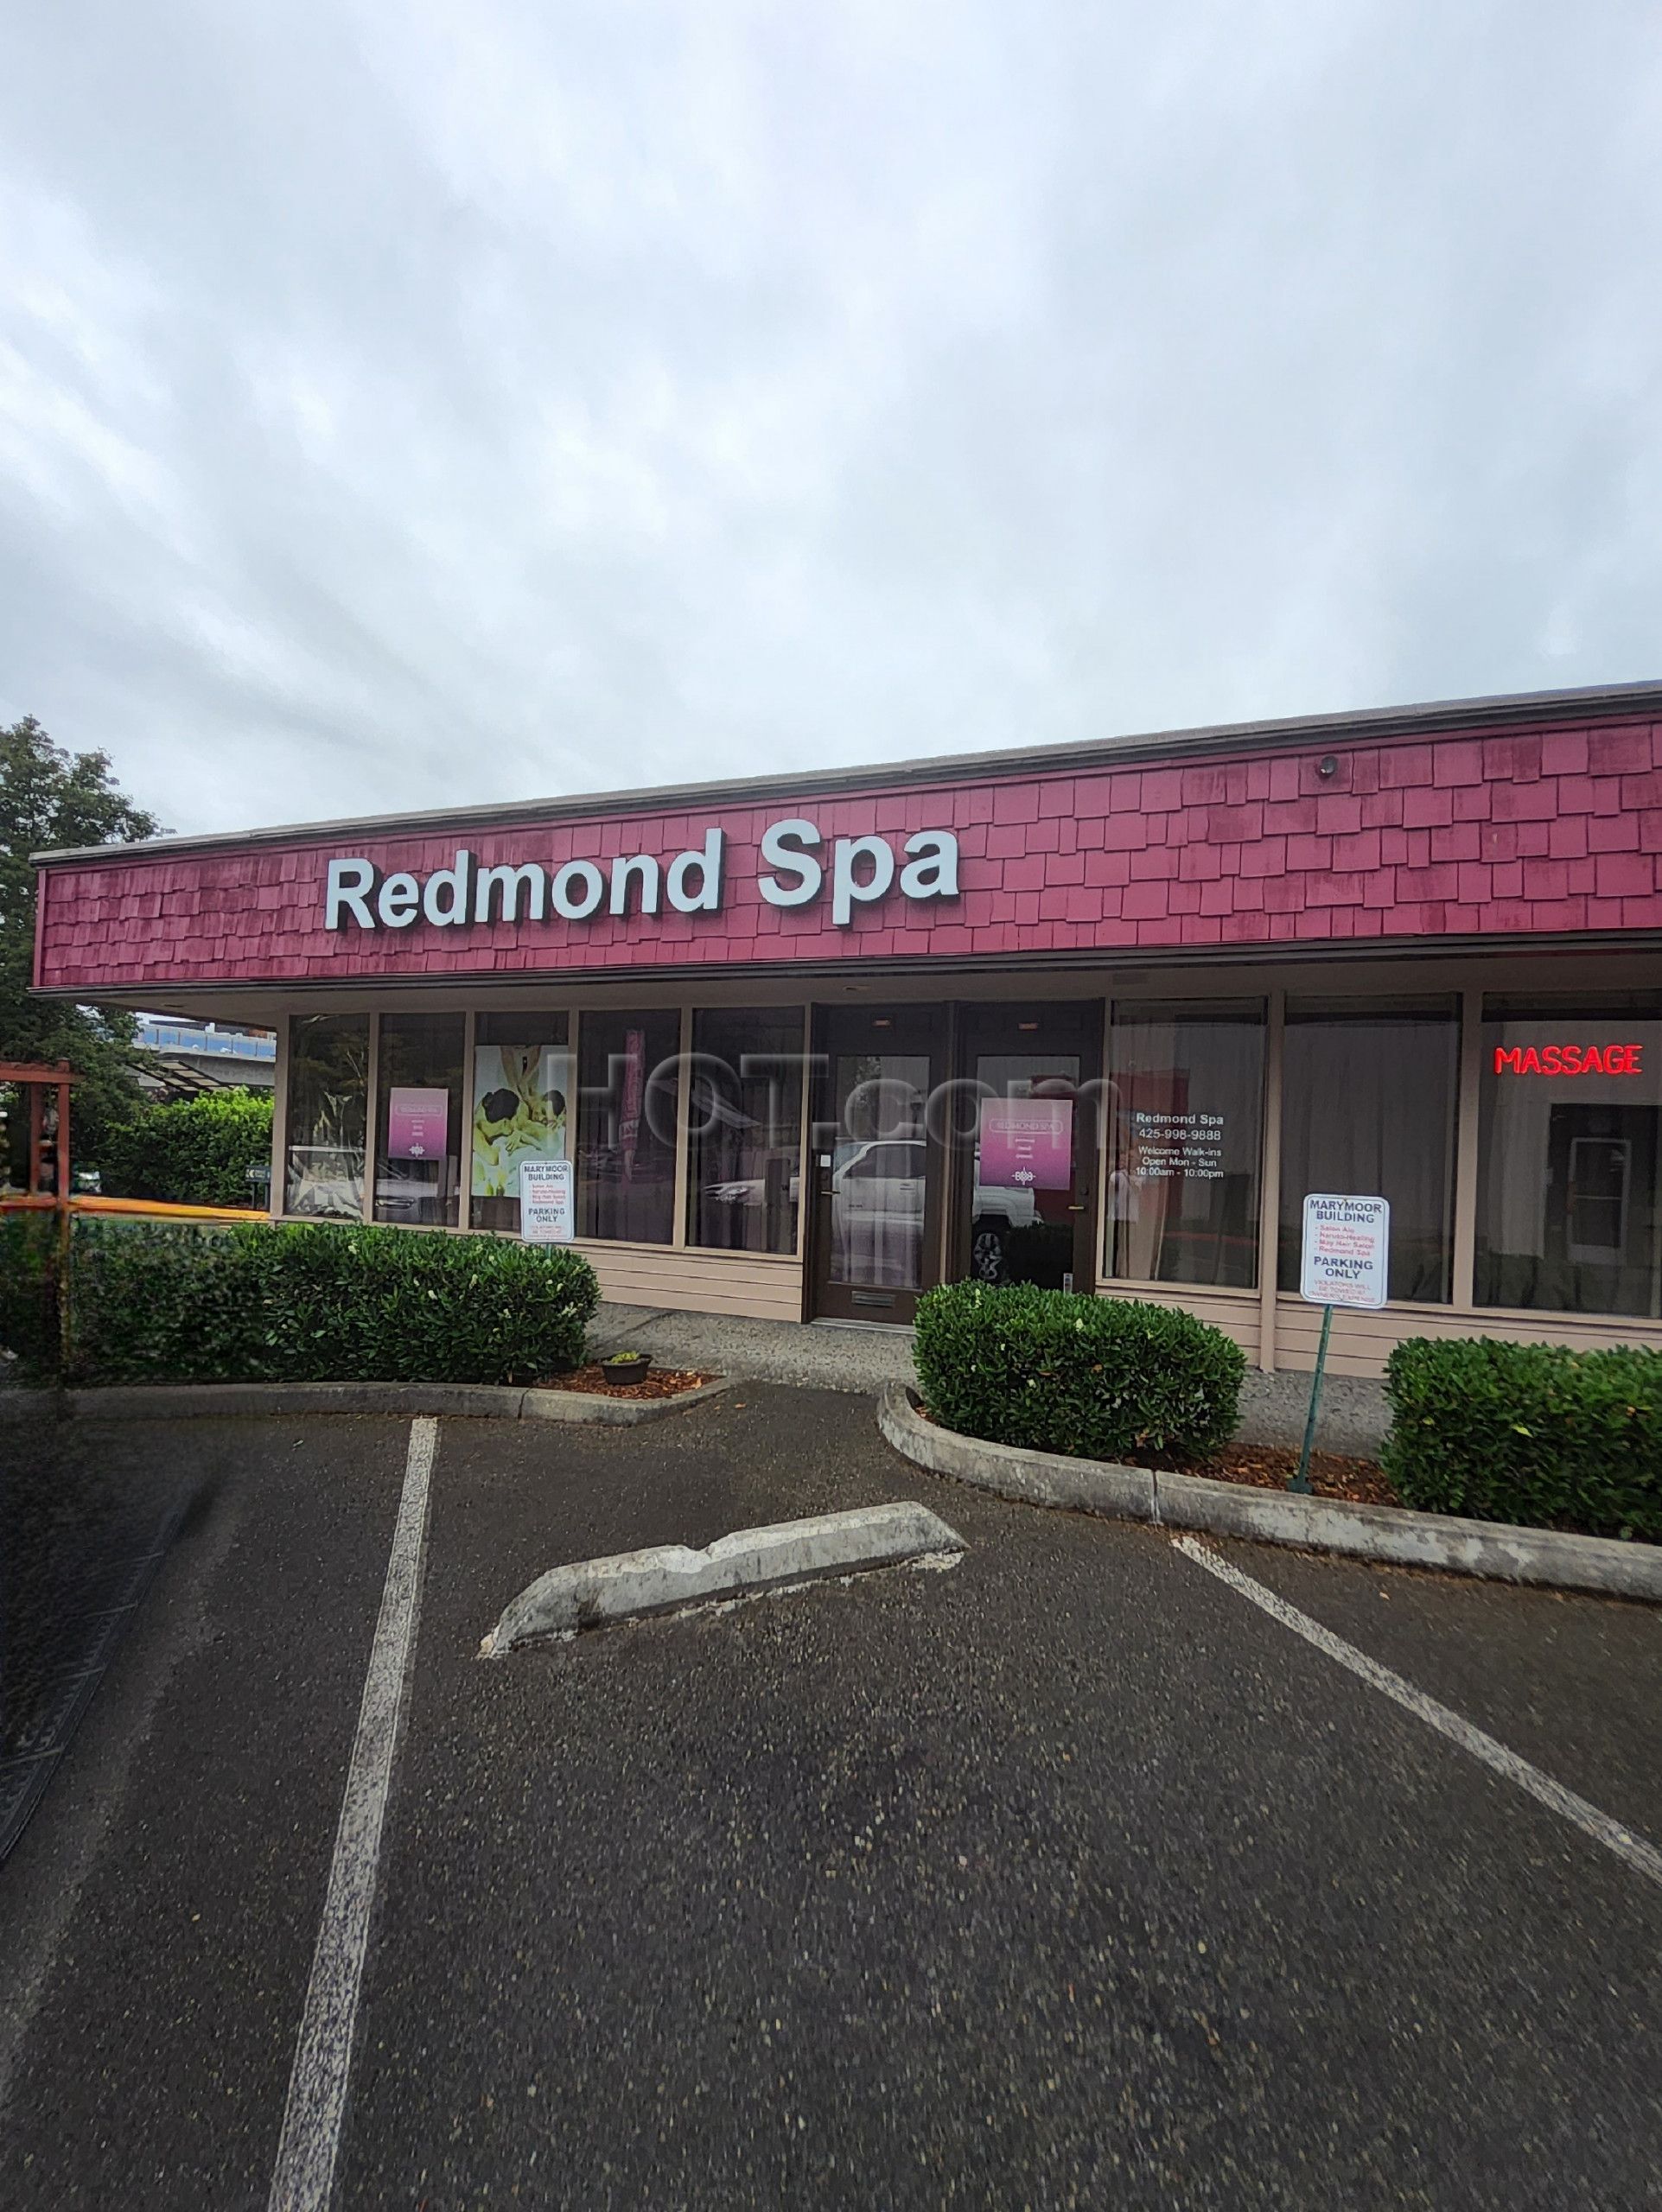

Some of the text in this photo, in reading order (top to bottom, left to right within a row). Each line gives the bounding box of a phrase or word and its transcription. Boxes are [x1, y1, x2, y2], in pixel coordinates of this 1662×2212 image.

[325, 818, 960, 931] Redmond Spa
[1494, 1044, 1643, 1075] MASSAGE
[1136, 1112, 1224, 1127] Redmond Spa
[1139, 1128, 1221, 1141] 425-998-9888
[1138, 1145, 1180, 1156] Welcome
[1142, 1156, 1167, 1166] Open
[1169, 1157, 1190, 1166] Mon
[1198, 1158, 1217, 1167] Sun
[1136, 1166, 1175, 1177] 10:00am
[1184, 1168, 1224, 1180] 10:00pm
[1309, 1199, 1382, 1213] MARYMOOR
[1316, 1211, 1375, 1224] BUILDING
[1314, 1256, 1373, 1270] PARKING
[1325, 1268, 1361, 1280] ONLY
